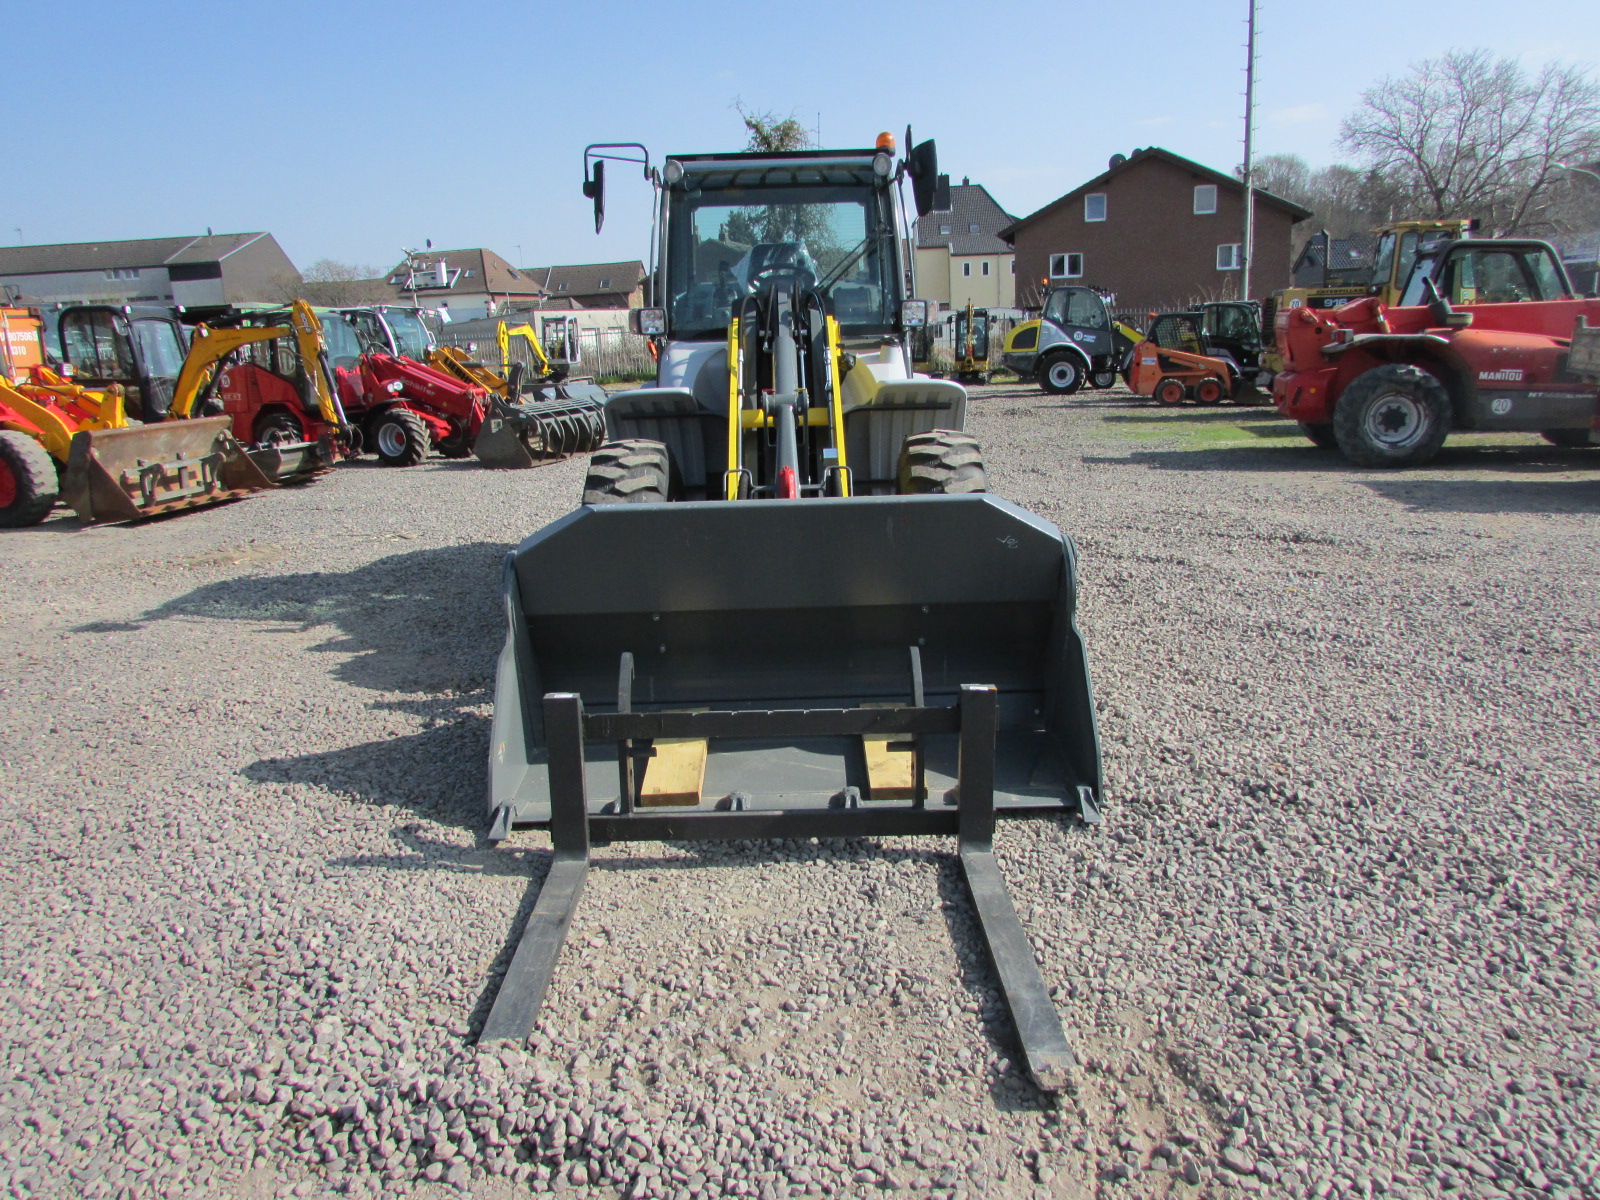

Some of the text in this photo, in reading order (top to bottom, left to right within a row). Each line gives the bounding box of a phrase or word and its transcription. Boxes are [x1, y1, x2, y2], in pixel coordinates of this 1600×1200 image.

[1324, 298, 1348, 307] 916
[1479, 369, 1523, 381] MANITOU
[1494, 401, 1507, 412] 20
